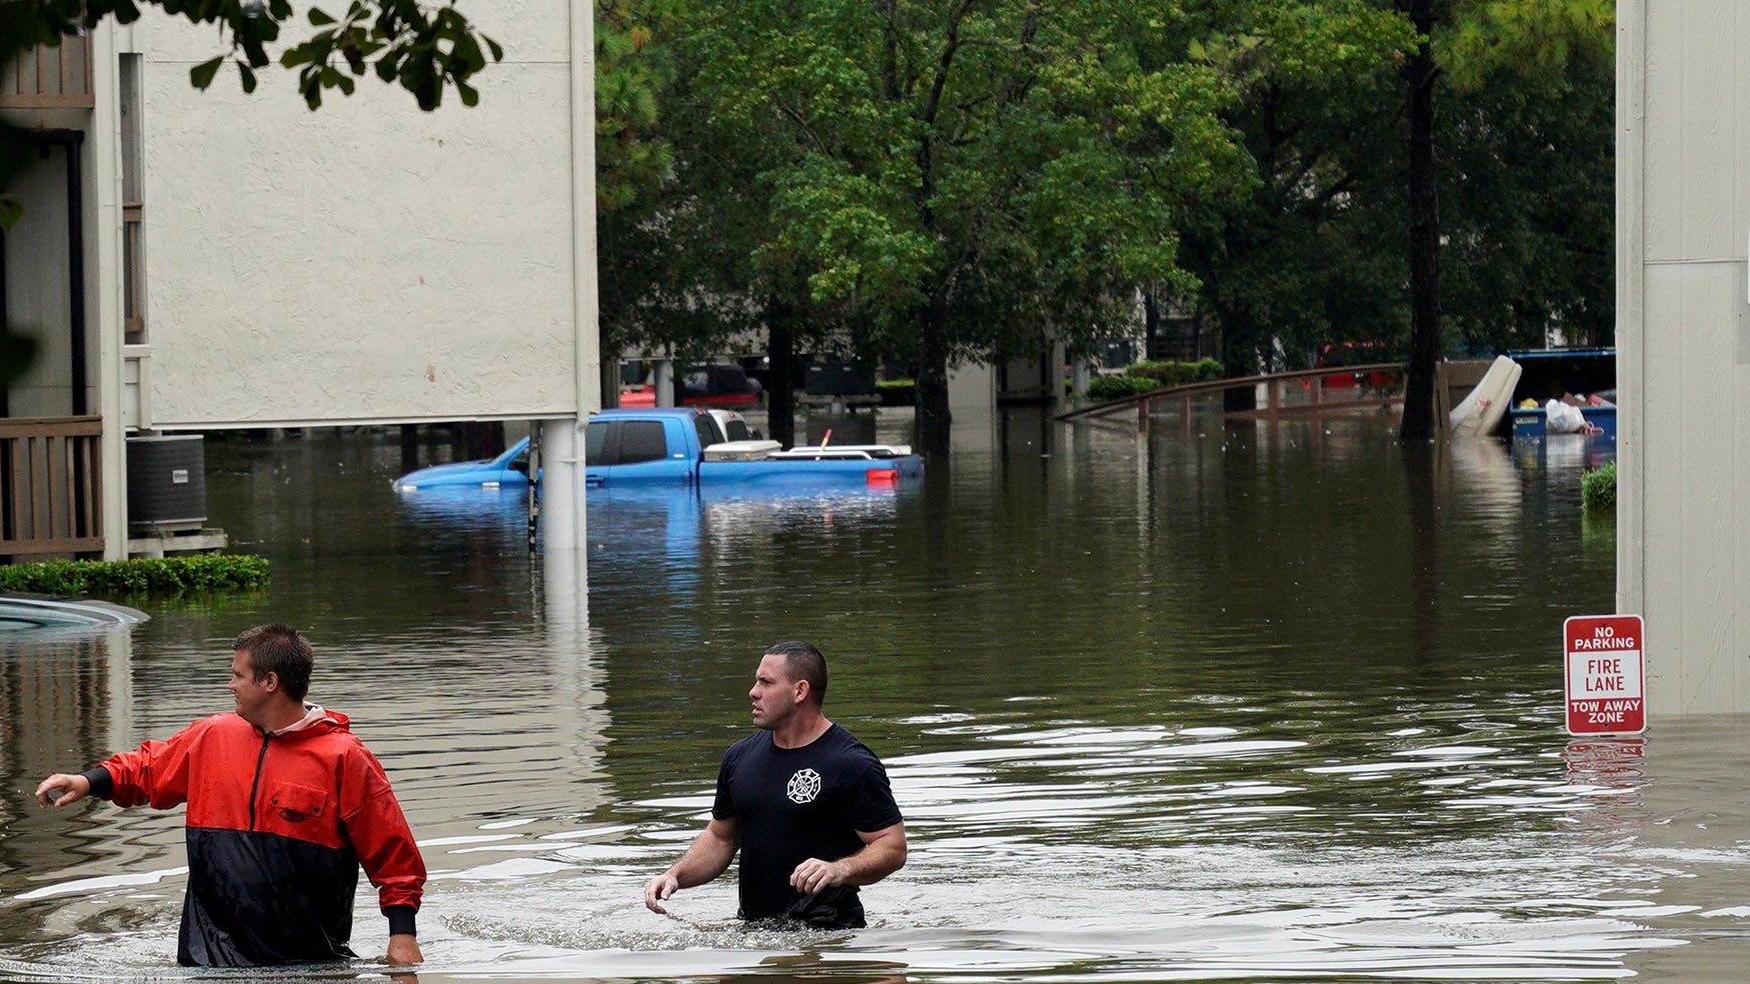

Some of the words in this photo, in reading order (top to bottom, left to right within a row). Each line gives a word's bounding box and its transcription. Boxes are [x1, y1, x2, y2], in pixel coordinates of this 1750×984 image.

[1595, 627, 1614, 637] NO
[1575, 637, 1635, 649] PARKING
[1588, 659, 1621, 674] FIRE
[1586, 676, 1625, 691] LANE
[1572, 702, 1599, 712] TOW
[1604, 700, 1641, 711] AWAY
[1589, 712, 1625, 723] ZONE
